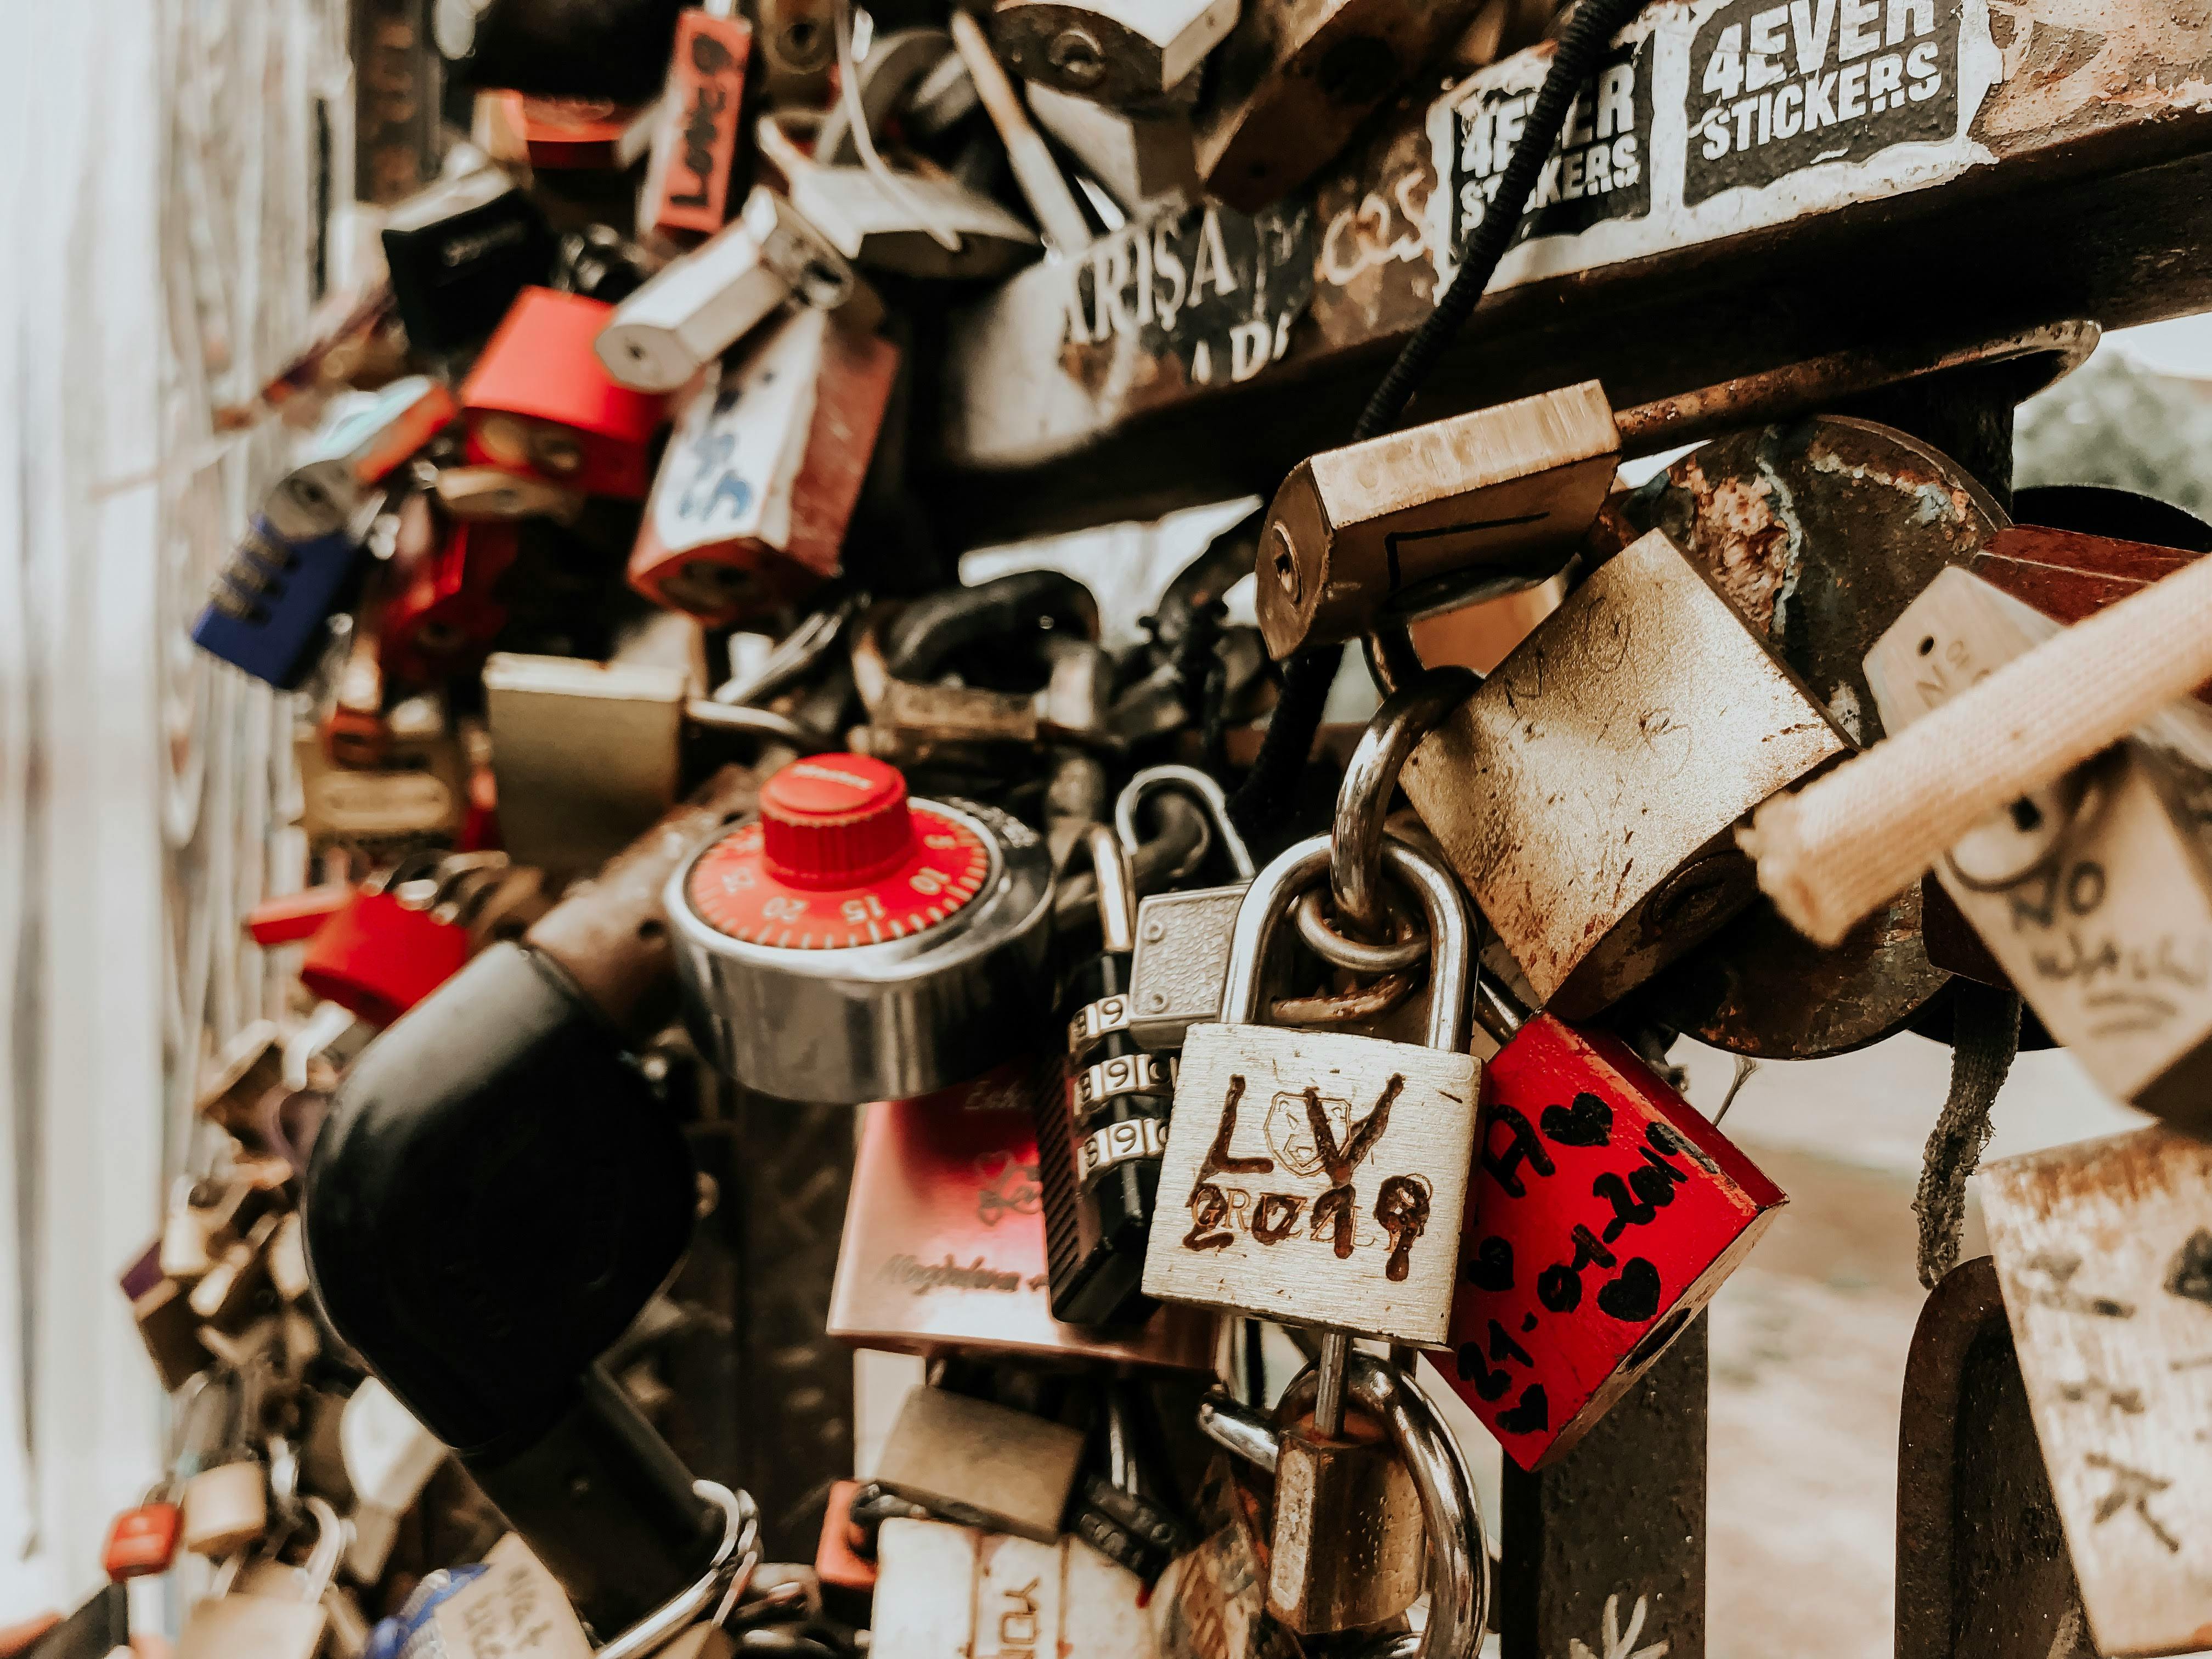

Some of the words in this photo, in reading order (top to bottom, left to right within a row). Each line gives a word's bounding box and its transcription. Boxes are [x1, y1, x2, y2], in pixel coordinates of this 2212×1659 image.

[1702, 0, 1936, 101] 4EVER
[1702, 41, 1943, 161] STICKERS
[761, 896, 809, 924] 20
[840, 895, 885, 924] 15
[1182, 1174, 1431, 1282] 2019
